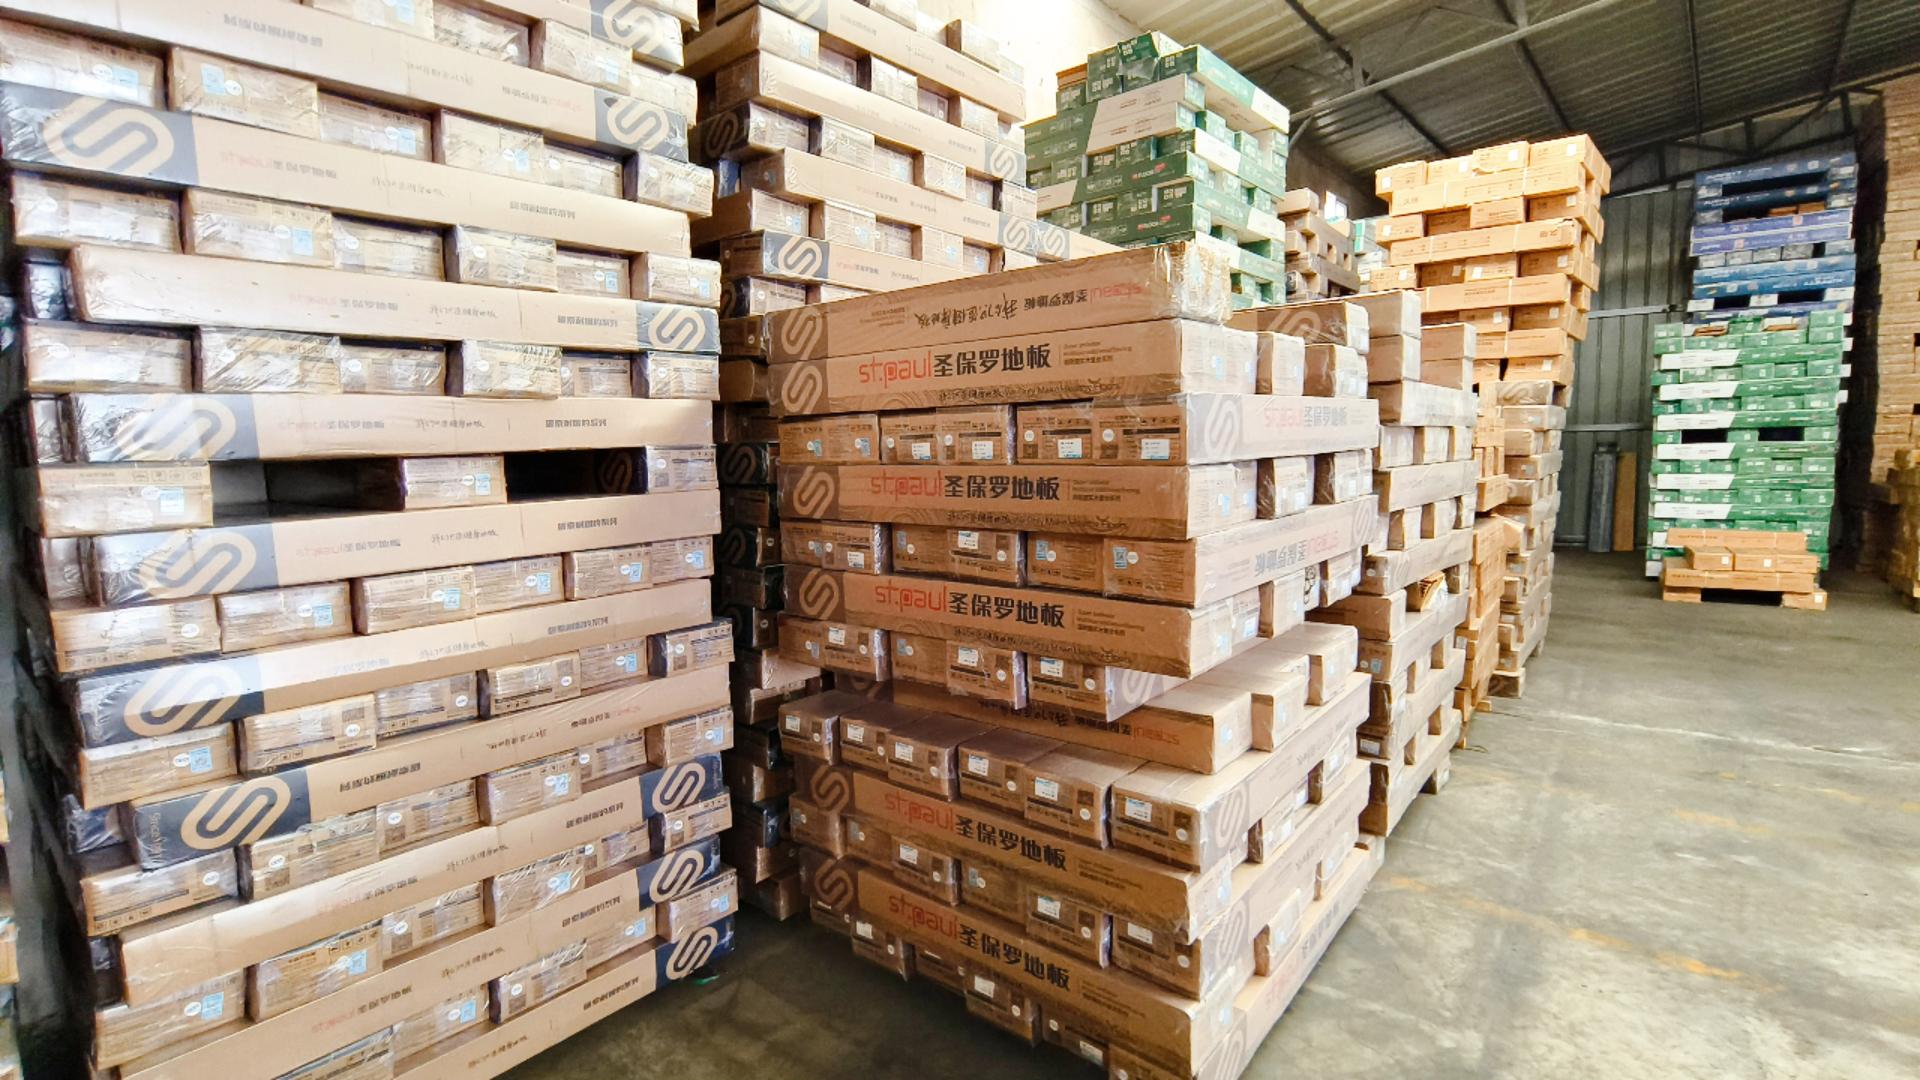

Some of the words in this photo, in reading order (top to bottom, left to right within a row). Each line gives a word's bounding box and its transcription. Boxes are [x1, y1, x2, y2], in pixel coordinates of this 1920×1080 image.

[858, 350, 932, 388] st.paul
[933, 343, 1052, 378] 圣保罗地板
[870, 470, 942, 502] st.paul
[943, 475, 1060, 501] 圣保罗地板
[875, 579, 947, 612] st.paul
[948, 591, 1066, 629] 圣保罗地板
[955, 813, 1067, 872] 圣保罗地板
[959, 923, 1071, 993] 圣保罗地板
